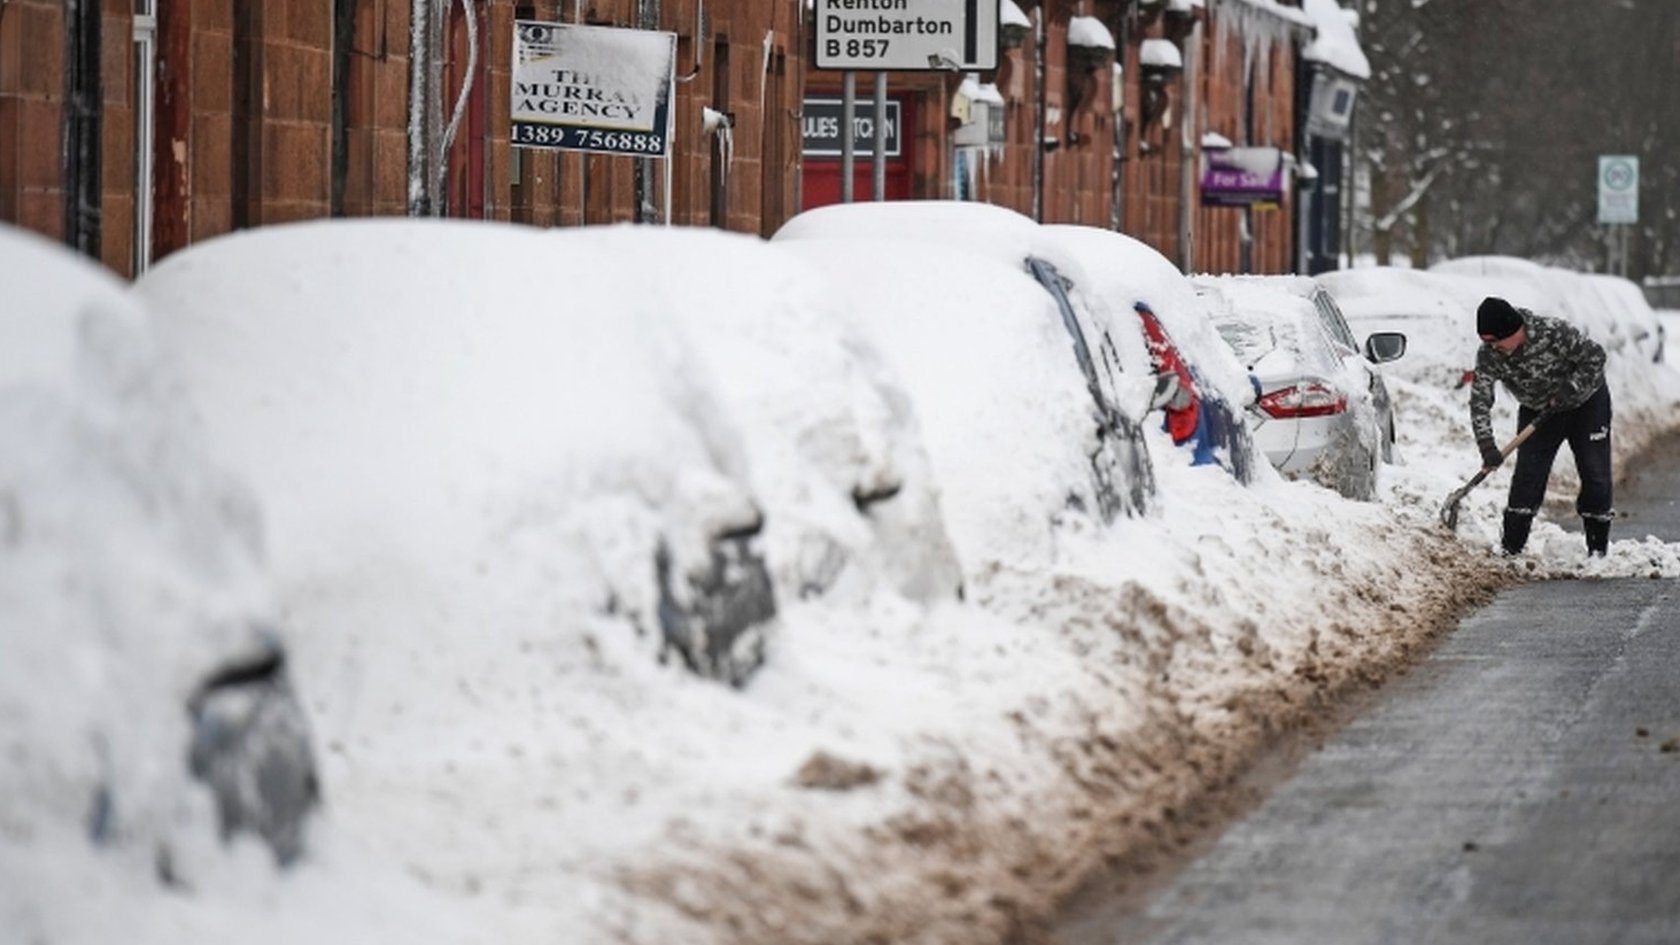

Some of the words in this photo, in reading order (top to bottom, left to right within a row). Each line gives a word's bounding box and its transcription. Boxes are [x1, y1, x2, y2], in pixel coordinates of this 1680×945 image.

[827, 0, 907, 9] Renton
[826, 15, 952, 34] Dumbarton
[826, 39, 840, 57] B
[846, 39, 890, 58] 857
[518, 99, 641, 119] AGENCY
[575, 129, 662, 151] 756888
[1214, 172, 1237, 187] For
[1240, 172, 1269, 188] Sa
